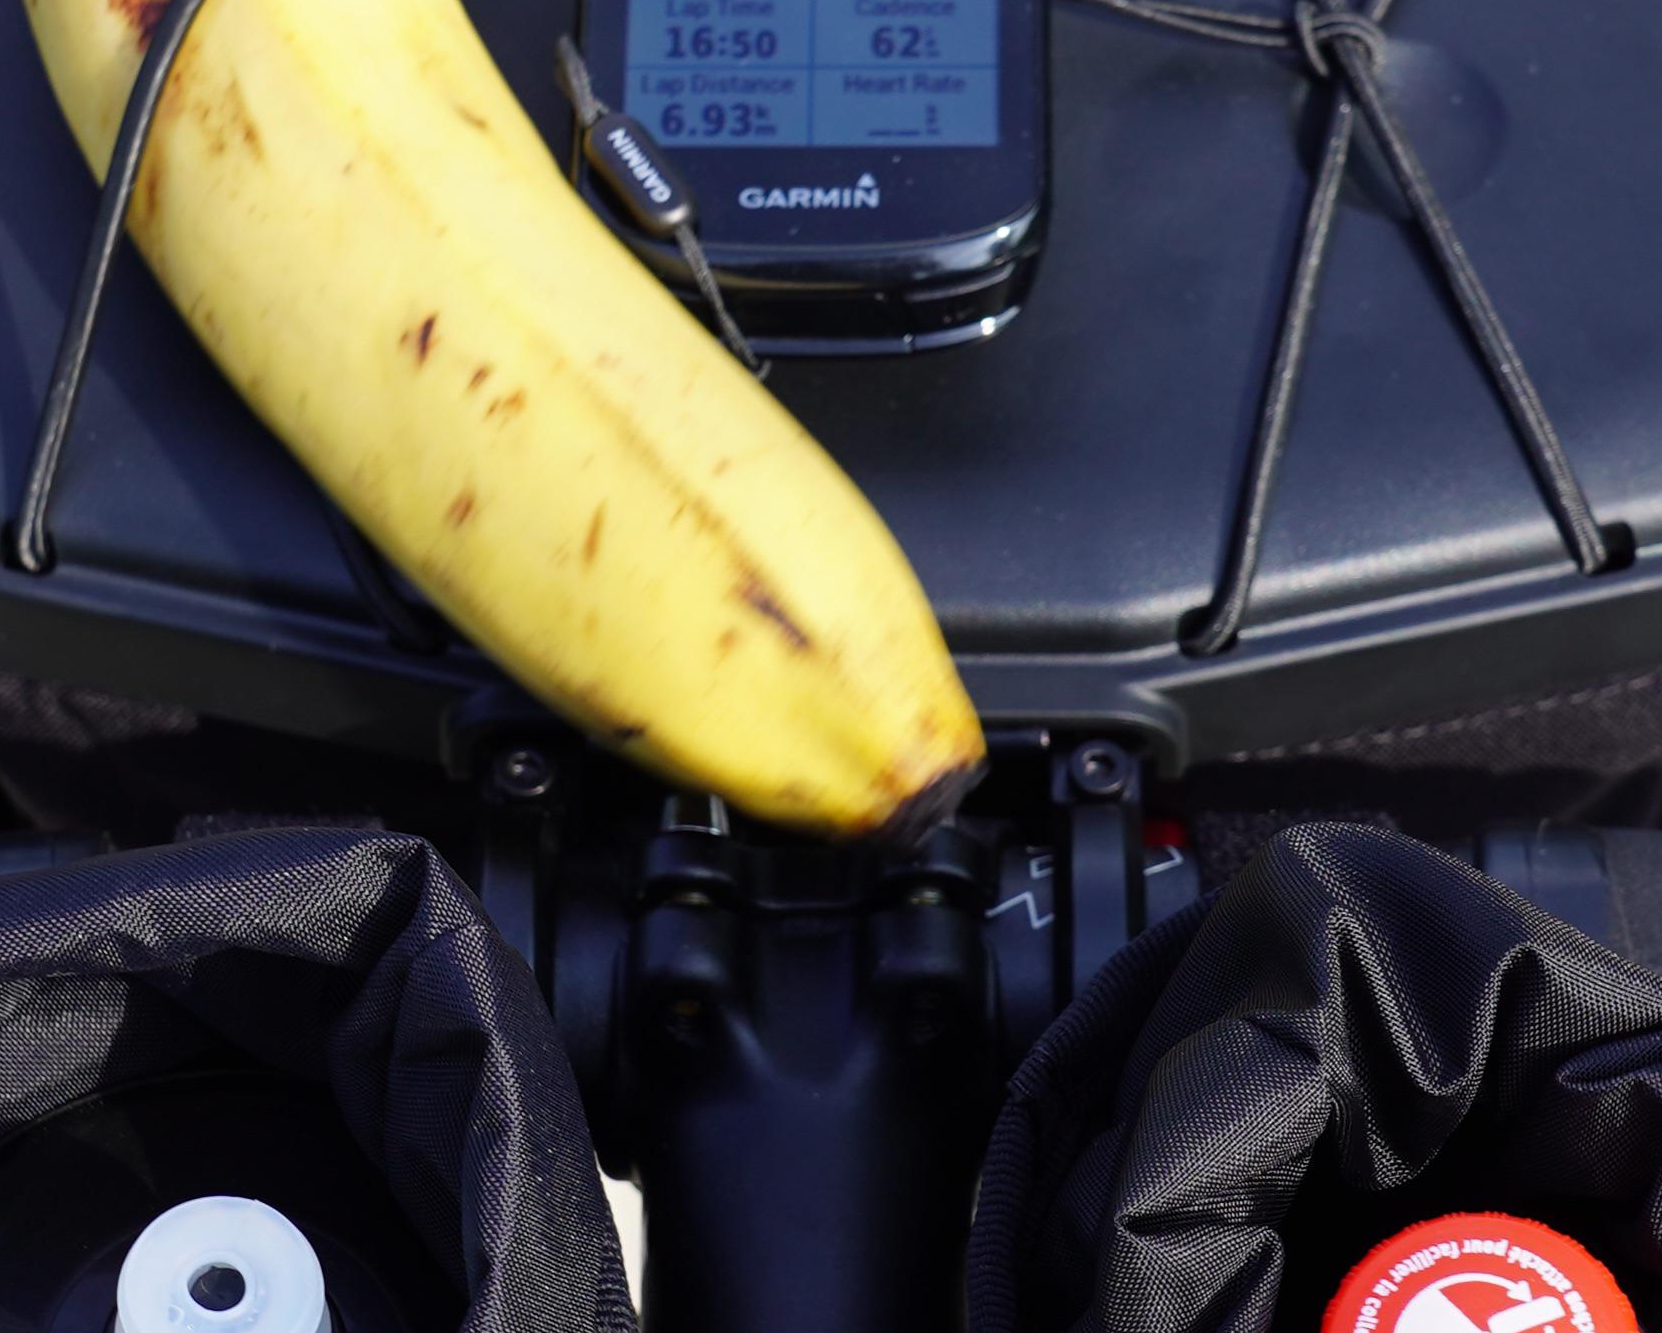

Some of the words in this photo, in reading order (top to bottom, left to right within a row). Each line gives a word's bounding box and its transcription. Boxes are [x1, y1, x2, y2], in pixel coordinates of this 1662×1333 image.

[664, 25, 779, 60] 16:50
[870, 24, 921, 59] 62
[639, 73, 685, 98] Lap
[690, 72, 796, 95] Distance
[843, 73, 907, 94] Heart
[912, 72, 967, 94] Rate
[660, 102, 753, 138] 6.93
[606, 127, 673, 204] GARMIN
[738, 185, 881, 210] GARMIN
[1388, 1240, 1461, 1284] faciliter
[1461, 1238, 1509, 1257] pour
[1506, 1244, 1573, 1294] attaché
[1371, 1278, 1400, 1297] la
